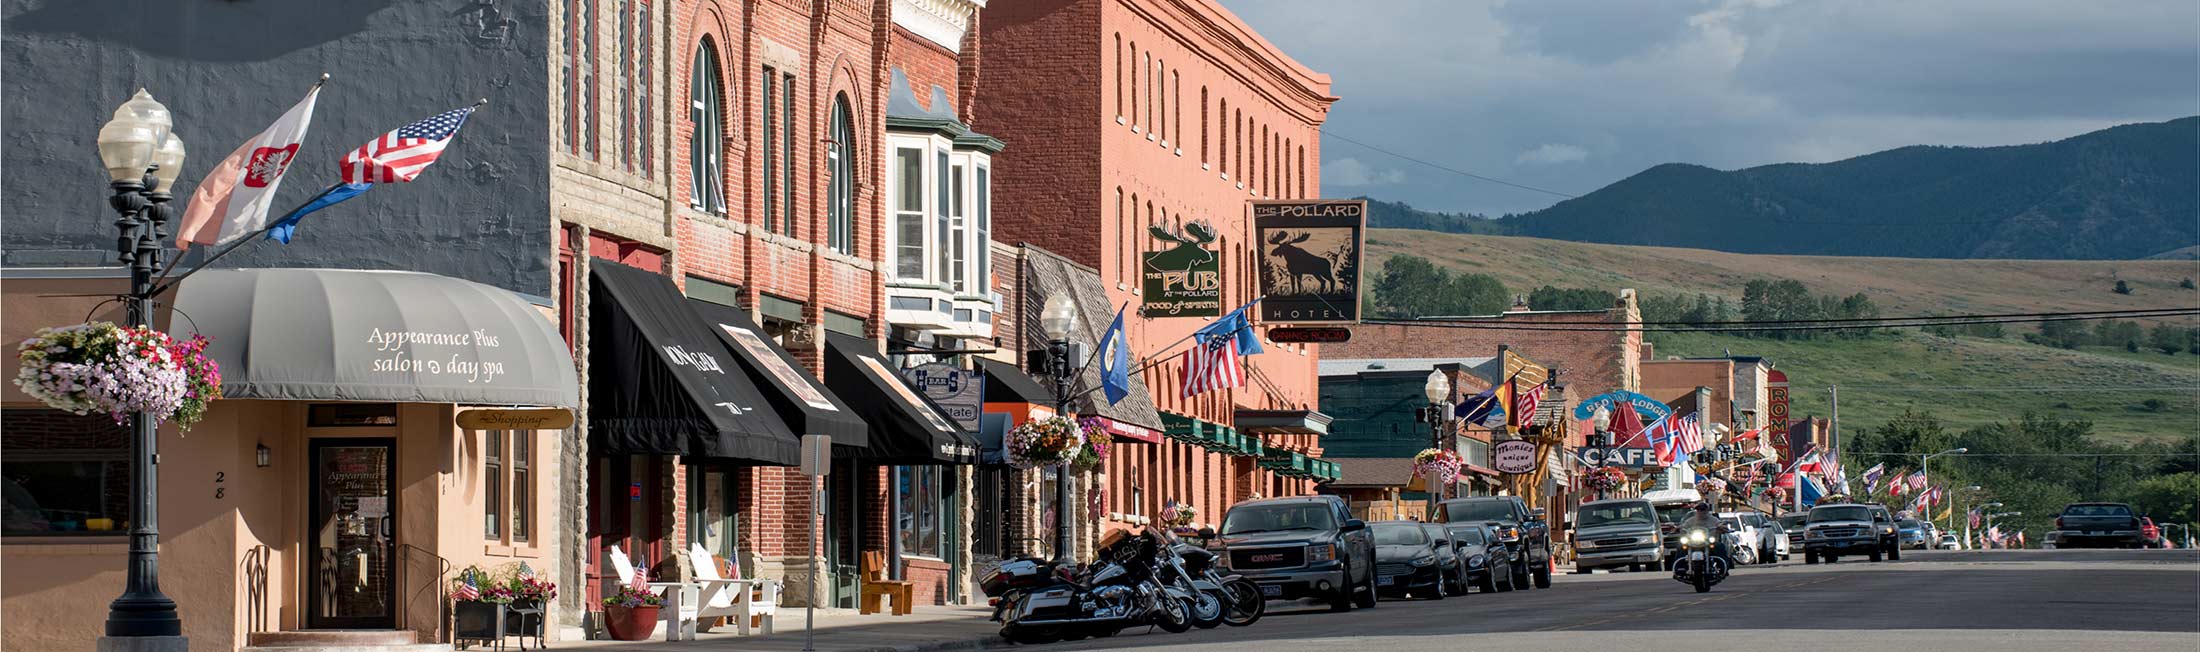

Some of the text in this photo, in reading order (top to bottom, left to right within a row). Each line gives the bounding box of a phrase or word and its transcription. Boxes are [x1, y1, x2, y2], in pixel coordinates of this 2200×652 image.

[1256, 205, 1361, 217] THE POLLARD
[1145, 270, 1219, 291] THE PUB
[1145, 300, 1219, 315] FOOD & SPIRITS
[1273, 309, 1344, 319] HOTEL
[367, 327, 500, 351] Appearance Plus
[1271, 330, 1345, 340] DINING ROOM
[373, 351, 423, 375] salon
[446, 353, 479, 383] day
[483, 360, 504, 383] spa
[928, 377, 948, 385] BAR
[1586, 398, 1668, 417] RED LODGE
[1770, 388, 1788, 461] ROMAN
[1503, 454, 1529, 462] unique
[1583, 448, 1659, 465] CAFE
[1499, 462, 1533, 472] boutique
[345, 479, 365, 490] Plus
[1251, 553, 1284, 563] GMC
